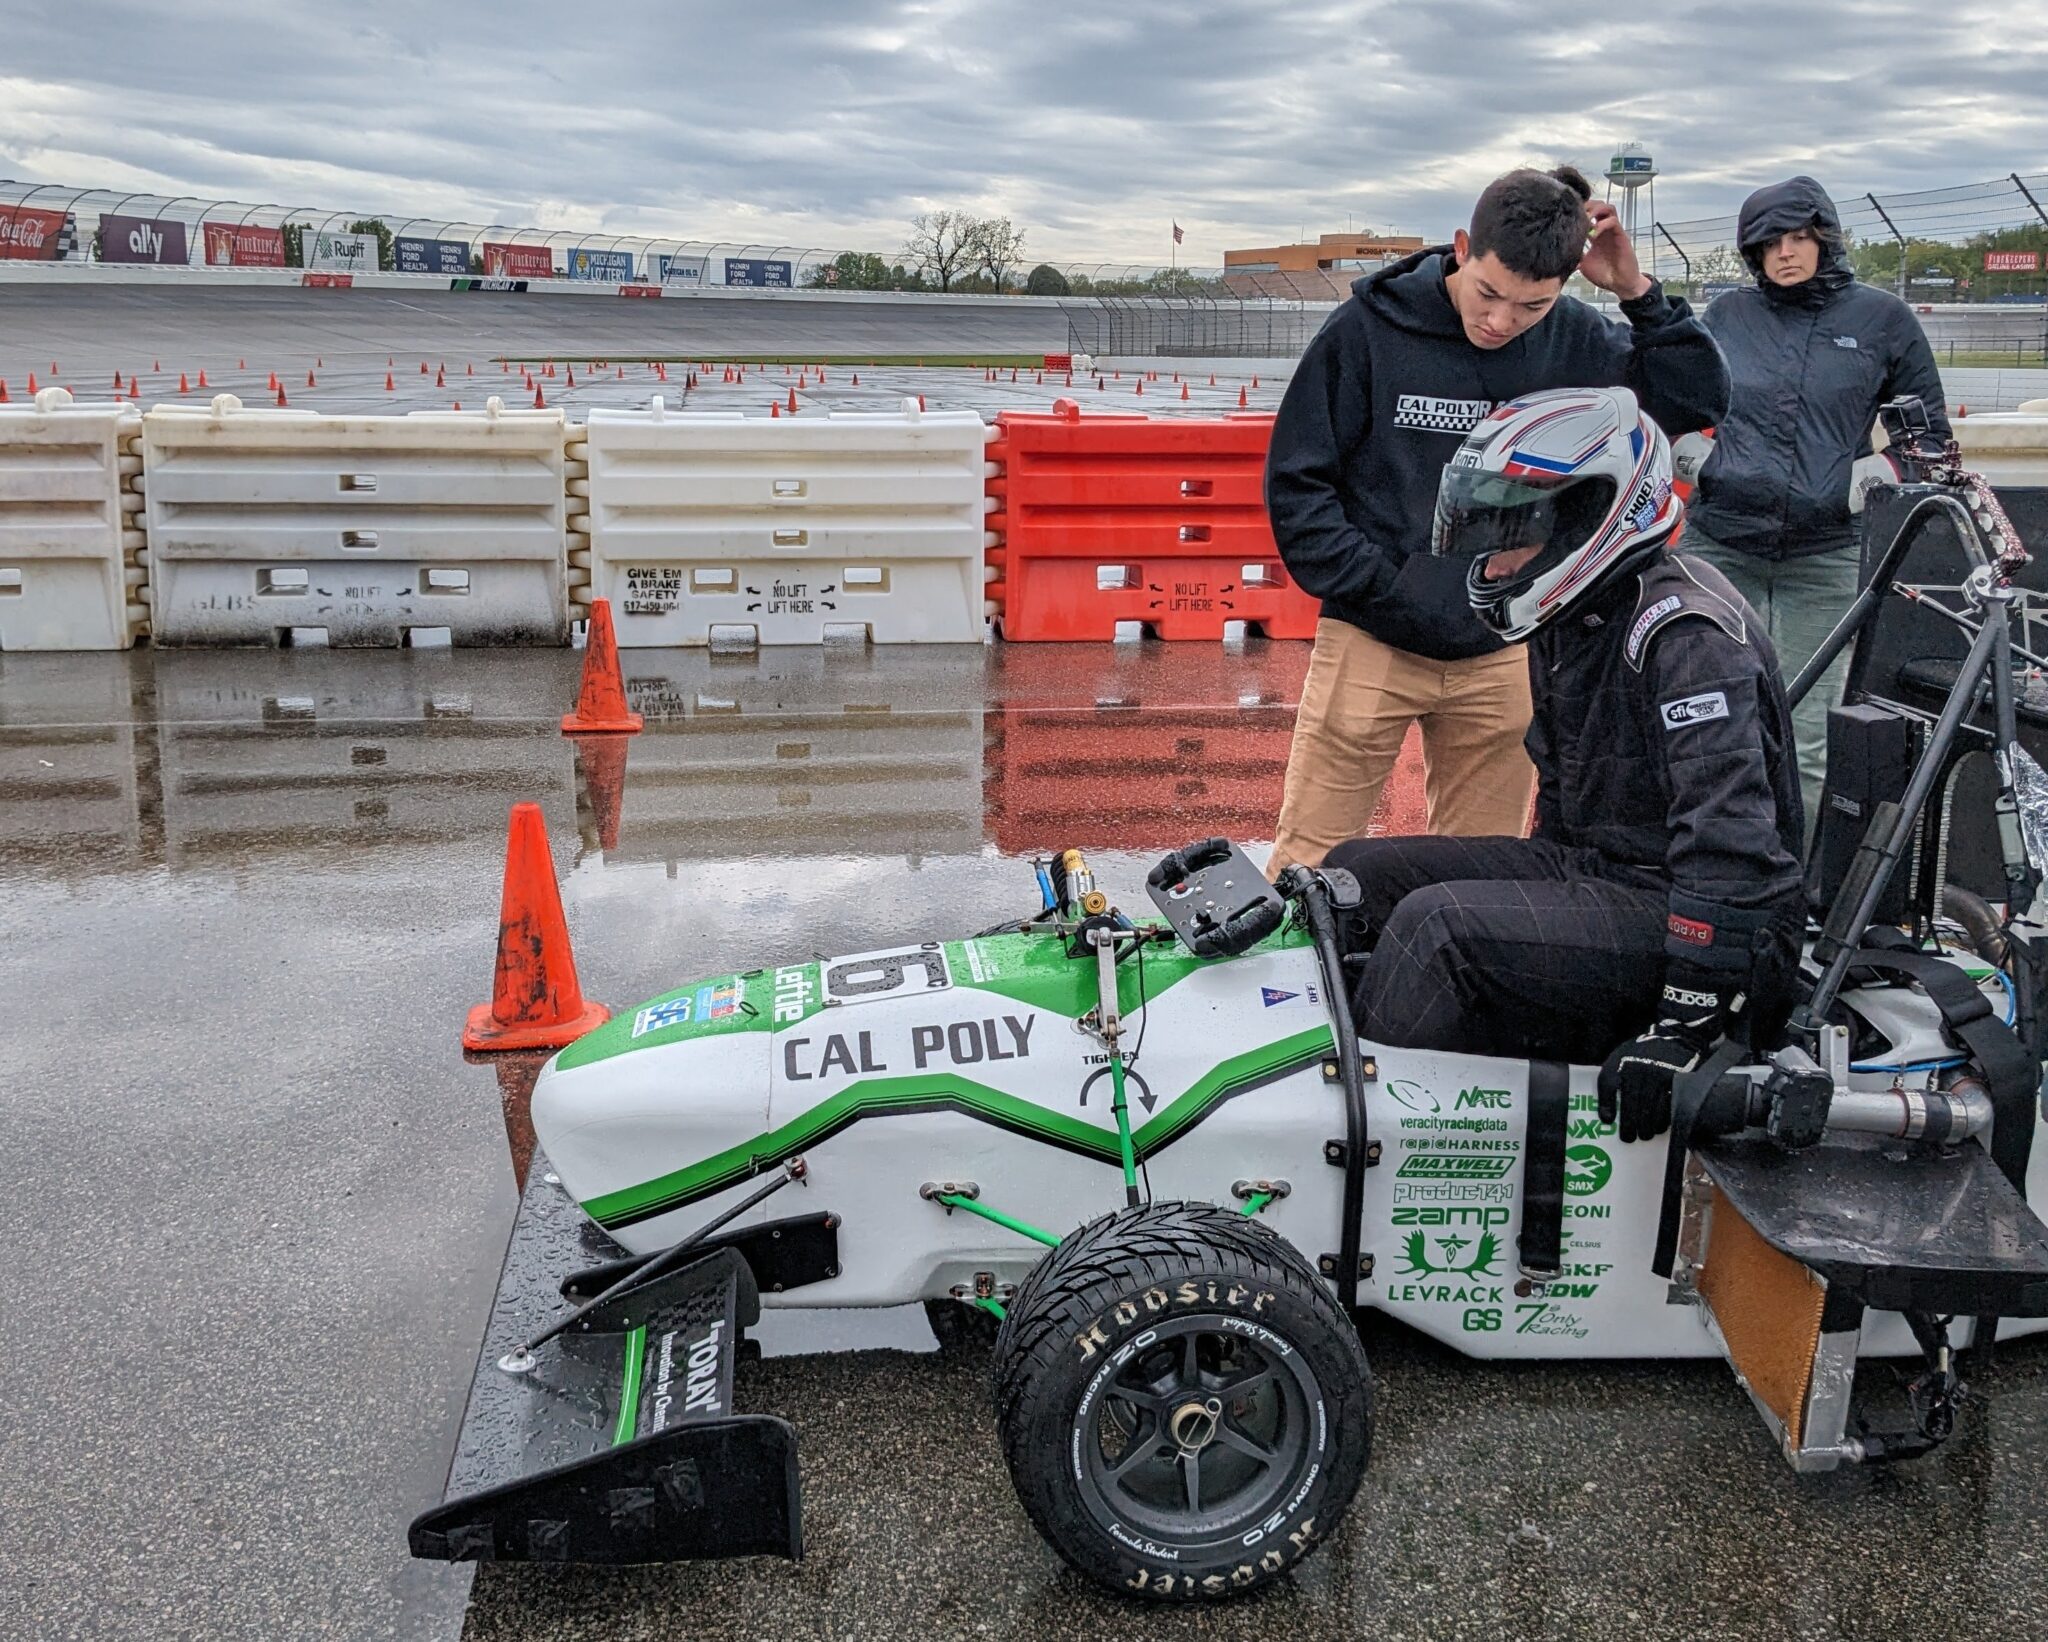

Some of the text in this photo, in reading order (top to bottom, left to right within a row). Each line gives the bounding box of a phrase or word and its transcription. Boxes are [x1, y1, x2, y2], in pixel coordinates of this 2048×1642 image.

[129, 223, 163, 262] ally
[334, 240, 365, 258] Ruoff
[400, 242, 424, 252] HENRY
[402, 251, 420, 262] FORD
[440, 246, 462, 254] HENRY
[442, 254, 458, 264] FORD
[590, 253, 626, 266] MICHIGAN
[402, 261, 428, 272] HEALTH
[442, 264, 466, 274] HEALTH
[590, 267, 626, 280] LOTTERY
[729, 263, 750, 271] HENRY
[764, 264, 784, 272] HENRY
[765, 272, 780, 280] FORD
[479, 279, 511, 291] MICHIGAN
[1399, 397, 1429, 411] CAL
[1434, 401, 1477, 416] POLY
[1624, 480, 1653, 525] SHOEI
[627, 568, 657, 579] GIVE
[627, 579, 681, 590] A BRAKE
[773, 584, 808, 598] NO LIFT
[1175, 583, 1208, 596] NO LIFT
[631, 589, 678, 600] SAFETY
[768, 601, 814, 614] LIFT HERE
[1169, 598, 1214, 612] LIFT HERE
[1670, 704, 1687, 719] sfi
[774, 964, 813, 1022] Leftie
[1306, 984, 1318, 1003] OFF
[648, 998, 691, 1031] SAE
[784, 1013, 1036, 1081] CAL POLY
[1081, 1051, 1140, 1065] TIGHEN
[1454, 1085, 1512, 1111] NATC
[1400, 1115, 1508, 1133] veracityracingdata
[1407, 1157, 1506, 1171] MAXWELL
[1567, 1181, 1594, 1191] SMX
[1391, 1207, 1510, 1231] zamp
[1570, 1241, 1601, 1249] CELSIUS
[1388, 1285, 1504, 1303] LEVRACK
[1462, 1308, 1502, 1331] GS
[1539, 1312, 1582, 1327] Only
[1525, 1323, 1589, 1339] Racing
[657, 1331, 679, 1383] Innovation
[653, 1380, 674, 1396] by
[1079, 1365, 1112, 1416] RACING
[1073, 1428, 1084, 1481] MAGNESIUM
[1288, 1463, 1320, 1512] RACING
[1108, 1523, 1180, 1561] Formula Student
